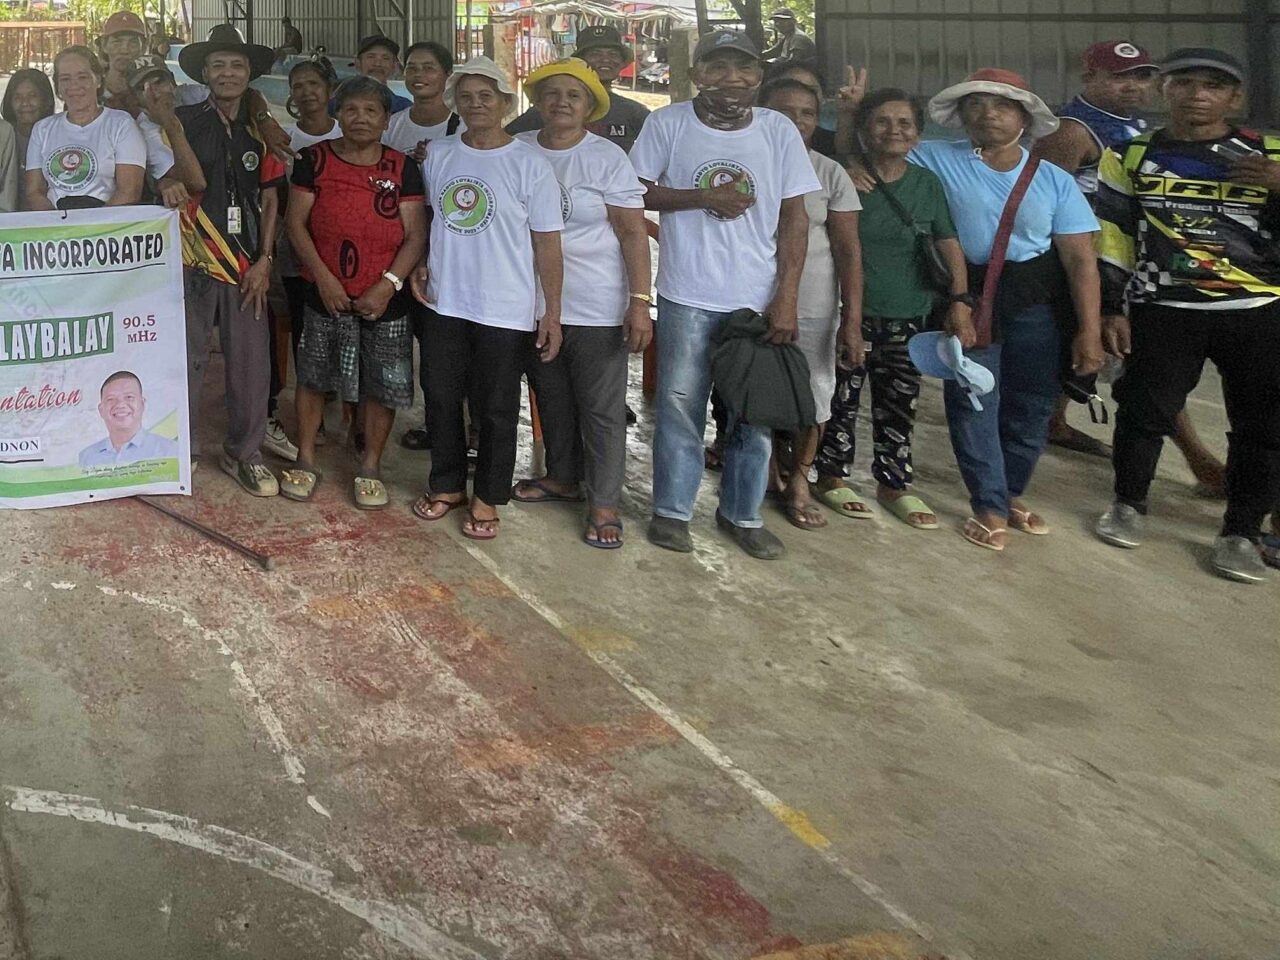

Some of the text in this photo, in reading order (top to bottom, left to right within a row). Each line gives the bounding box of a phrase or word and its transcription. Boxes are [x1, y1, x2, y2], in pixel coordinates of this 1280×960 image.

[134, 56, 155, 69] NY
[610, 125, 625, 136] AJ
[22, 232, 164, 271] INCORPORATED
[122, 314, 156, 329] 90.5
